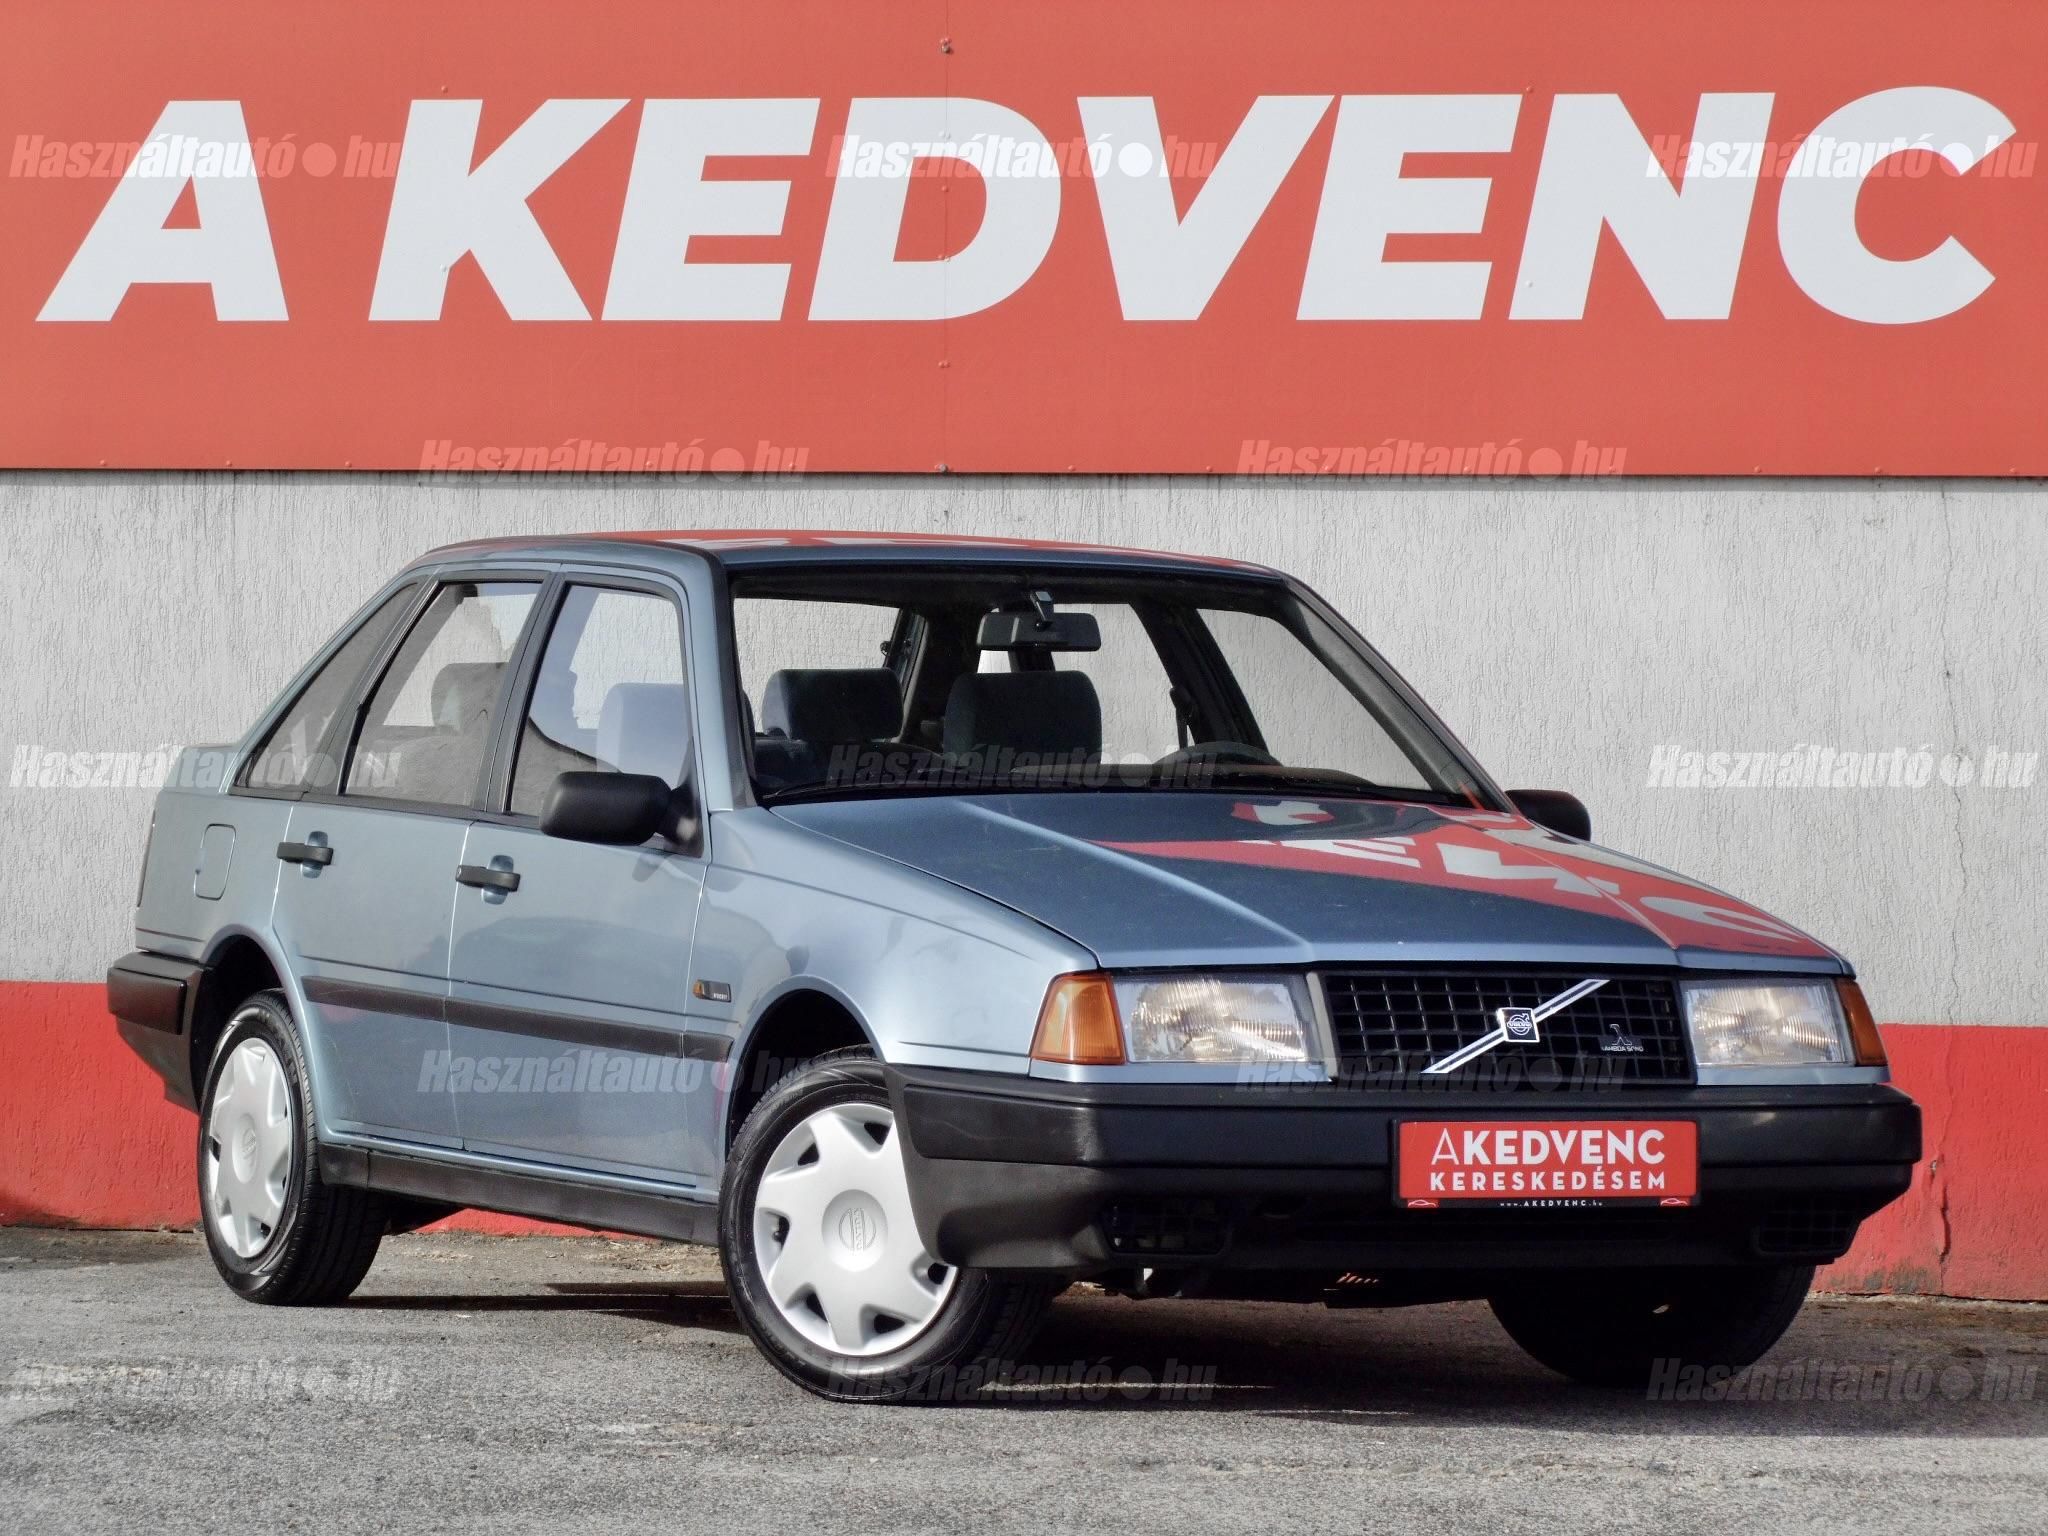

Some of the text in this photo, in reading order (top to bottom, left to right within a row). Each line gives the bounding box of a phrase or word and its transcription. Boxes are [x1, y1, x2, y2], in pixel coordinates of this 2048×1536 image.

[36, 85, 2017, 325] A KEDVENC
[1430, 1166, 1666, 1191] KERESKEDÉSEM
